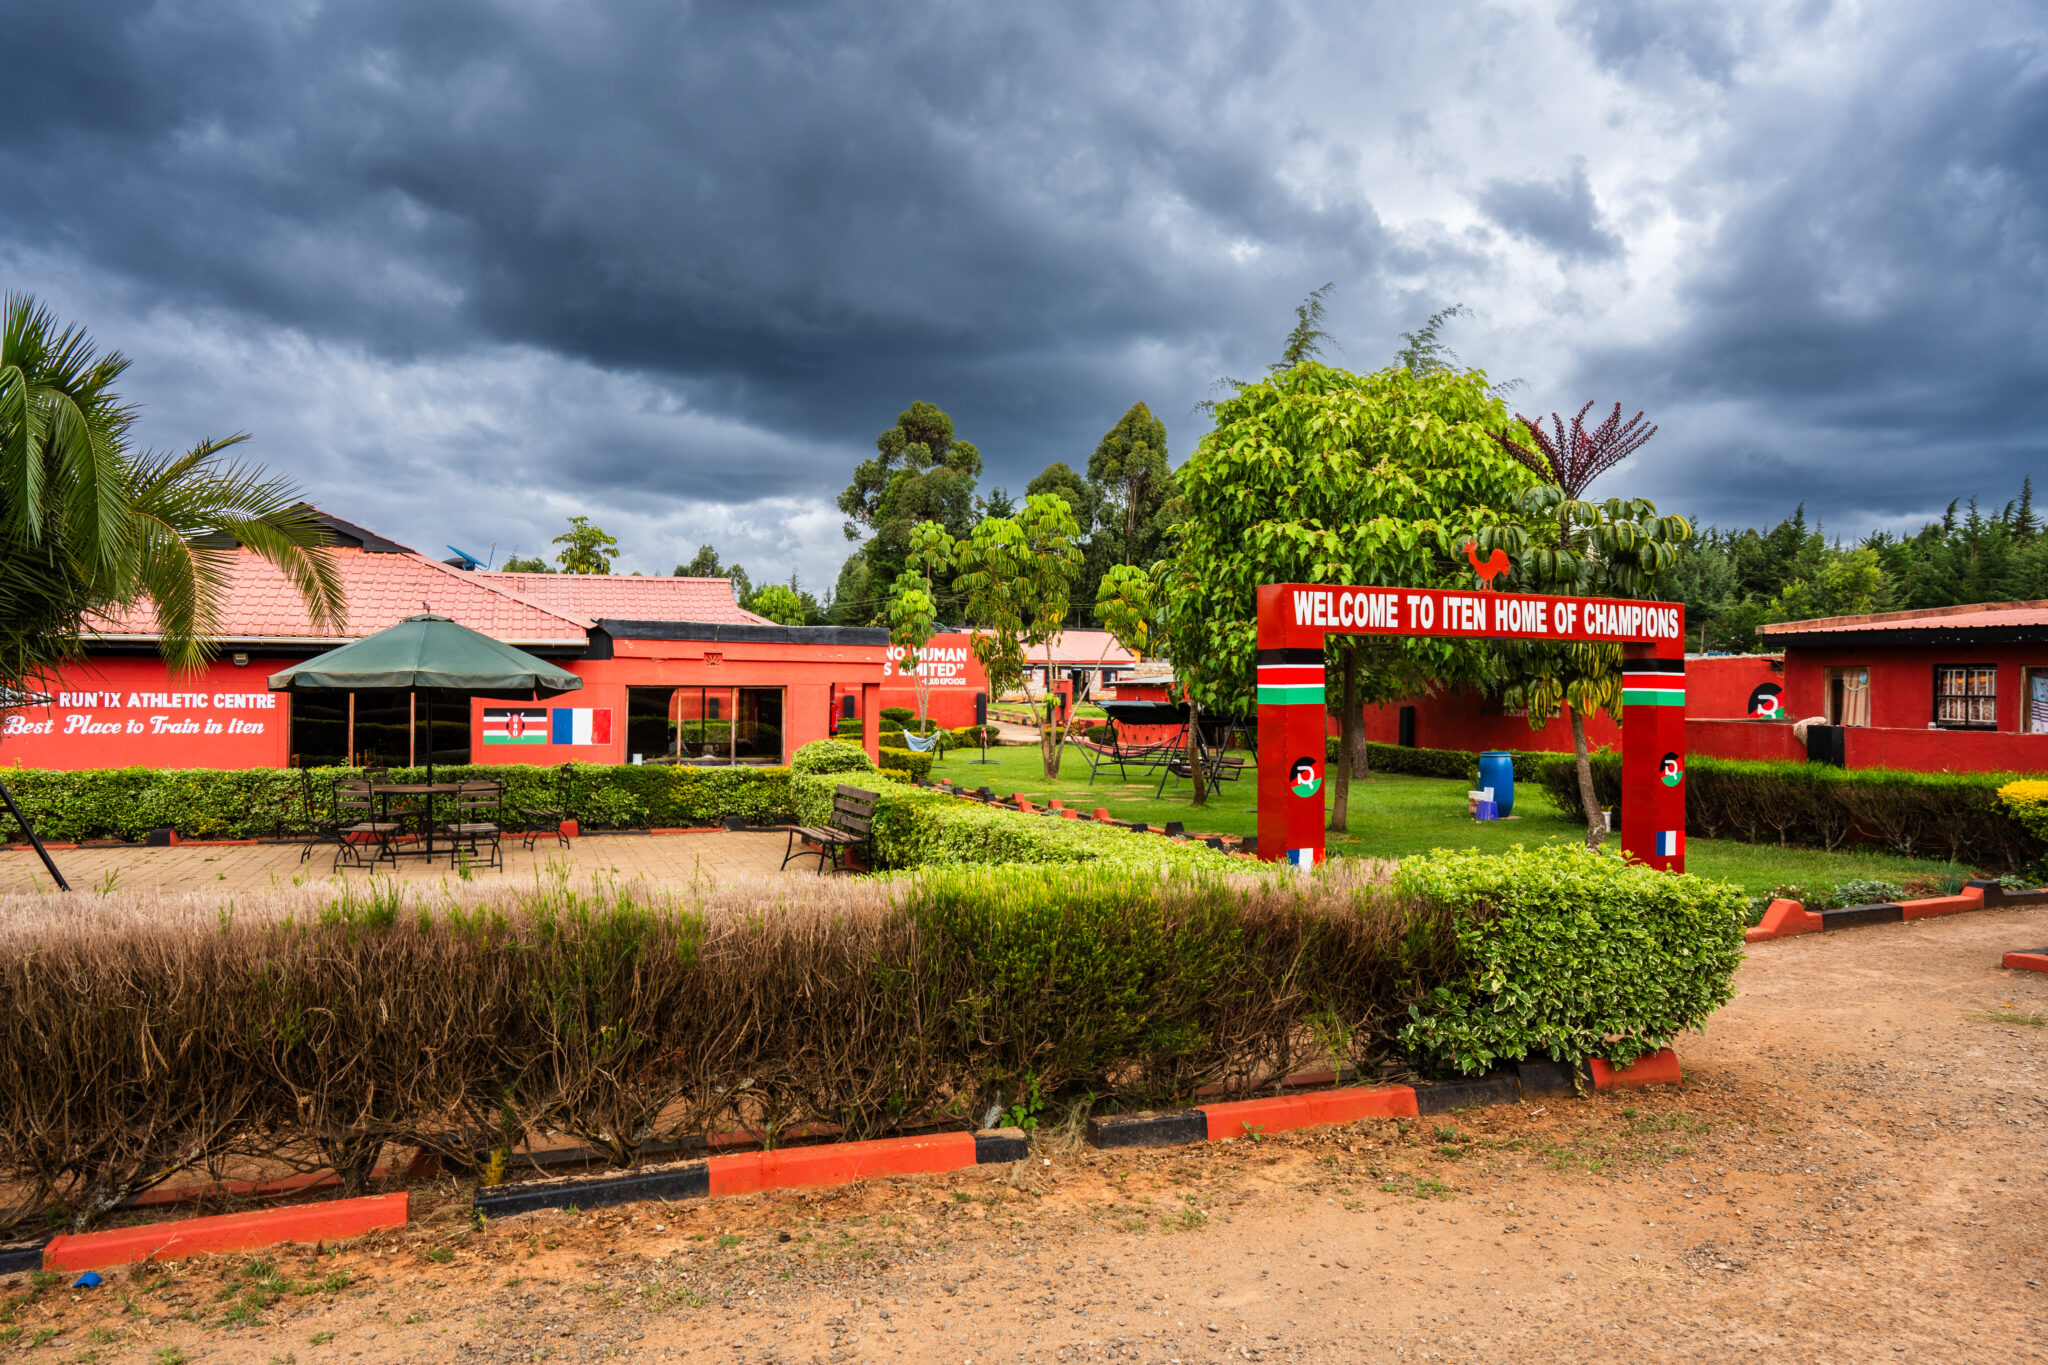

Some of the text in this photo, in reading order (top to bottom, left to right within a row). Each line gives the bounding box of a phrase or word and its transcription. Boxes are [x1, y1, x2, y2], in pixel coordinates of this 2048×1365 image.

[1293, 590, 1679, 639] WELCOME TO ITEN HOME OF CHAMPIONS
[911, 647, 967, 662] HUMAN
[883, 662, 892, 676] S
[60, 690, 121, 708] RUN'IX
[126, 692, 208, 708] ATHLETIC
[213, 693, 275, 709] CENTRE
[3, 715, 54, 735] Best
[63, 714, 122, 735] Place
[126, 719, 144, 734] to
[149, 715, 200, 734] Train
[204, 718, 223, 734] in
